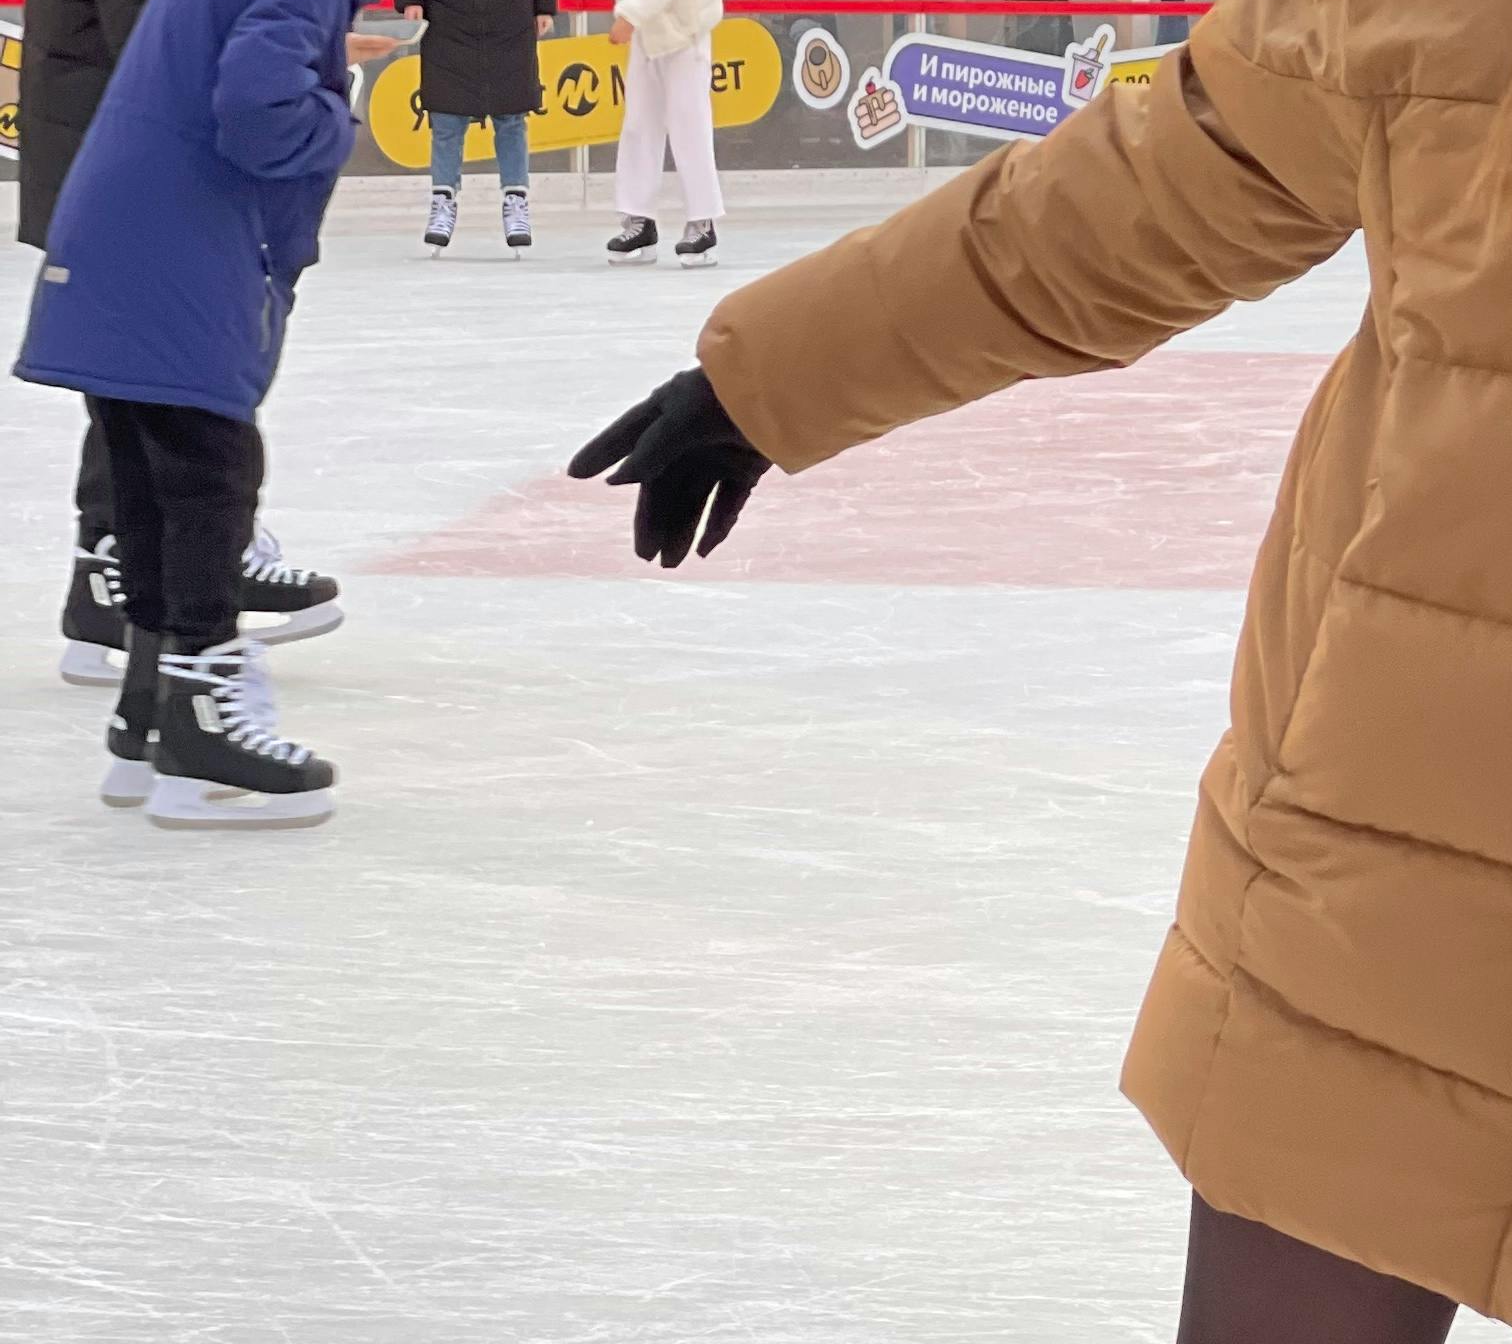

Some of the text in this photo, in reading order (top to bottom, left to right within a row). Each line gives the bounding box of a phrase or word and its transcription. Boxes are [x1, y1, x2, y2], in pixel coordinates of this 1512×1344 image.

[920, 53, 1057, 98] И пирожные
[913, 83, 1059, 124] и мороженое
